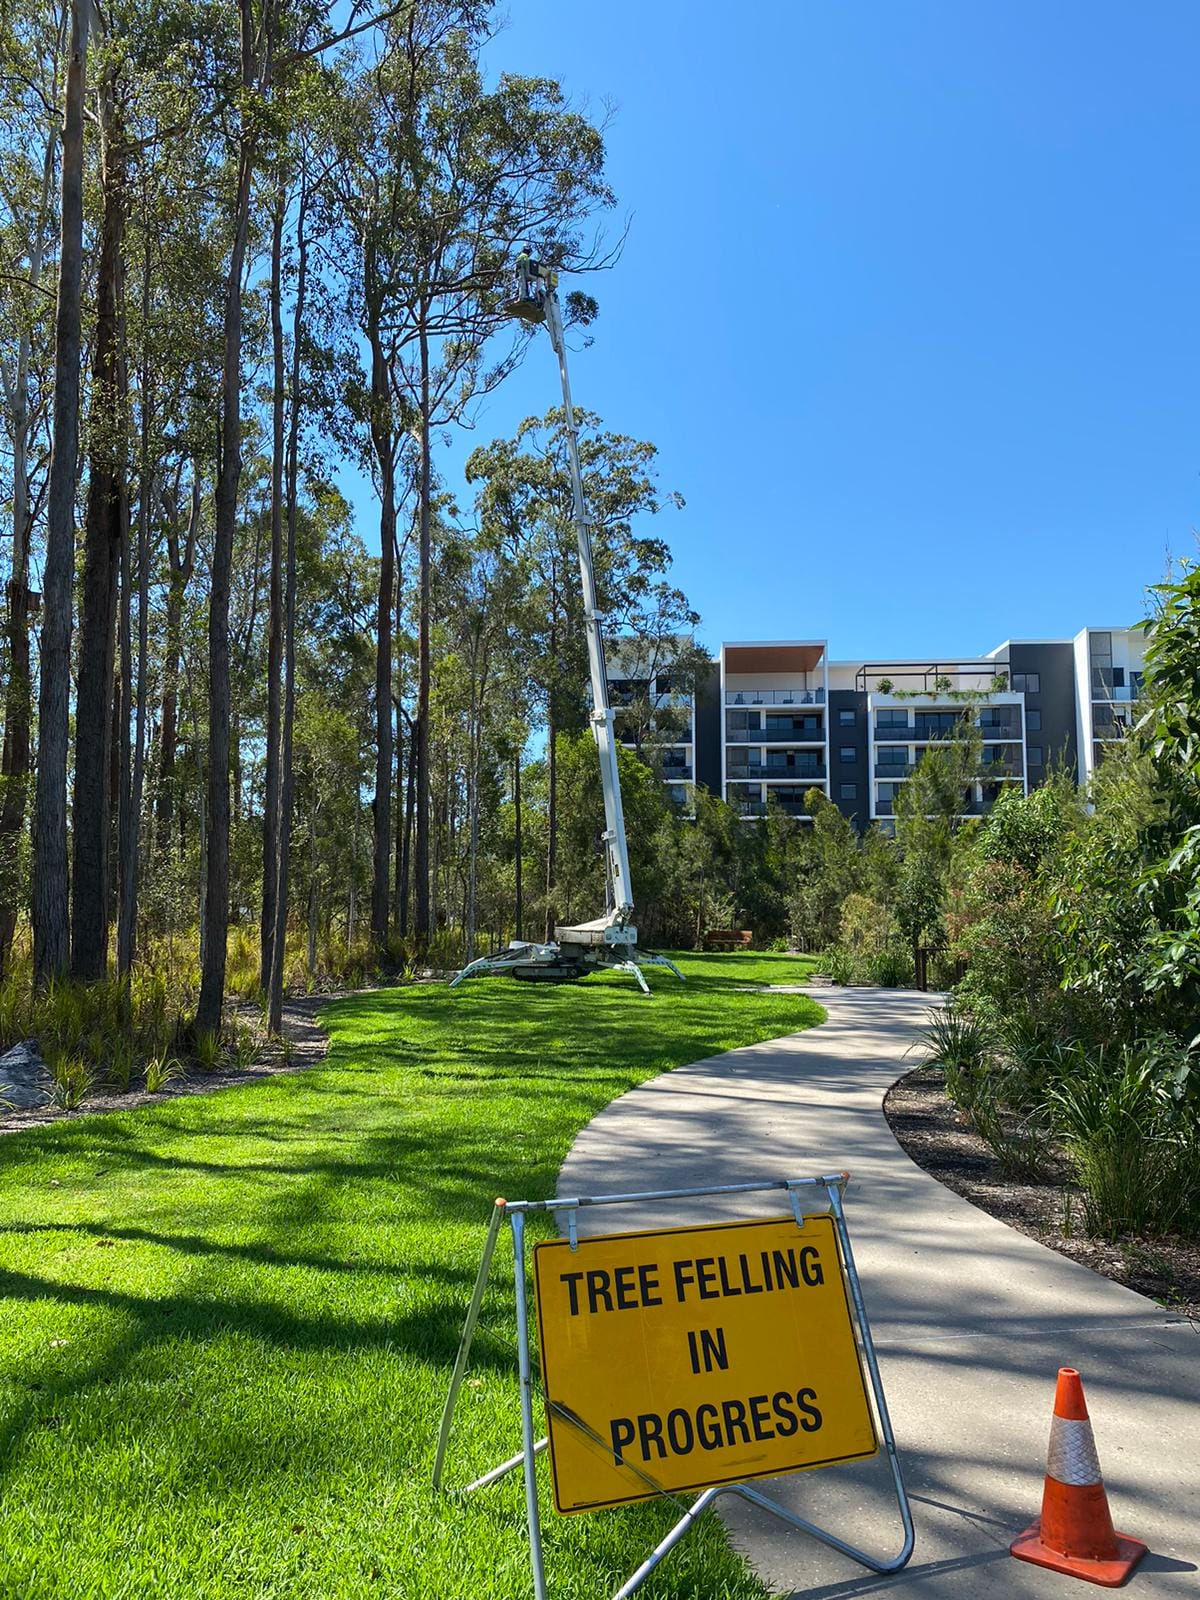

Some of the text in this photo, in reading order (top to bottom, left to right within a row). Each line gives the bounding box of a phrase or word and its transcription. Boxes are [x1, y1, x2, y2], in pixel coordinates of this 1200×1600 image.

[560, 1246, 825, 1316] TREE FELLING
[687, 1327, 729, 1374] IN
[610, 1388, 823, 1466] PROGRESS
